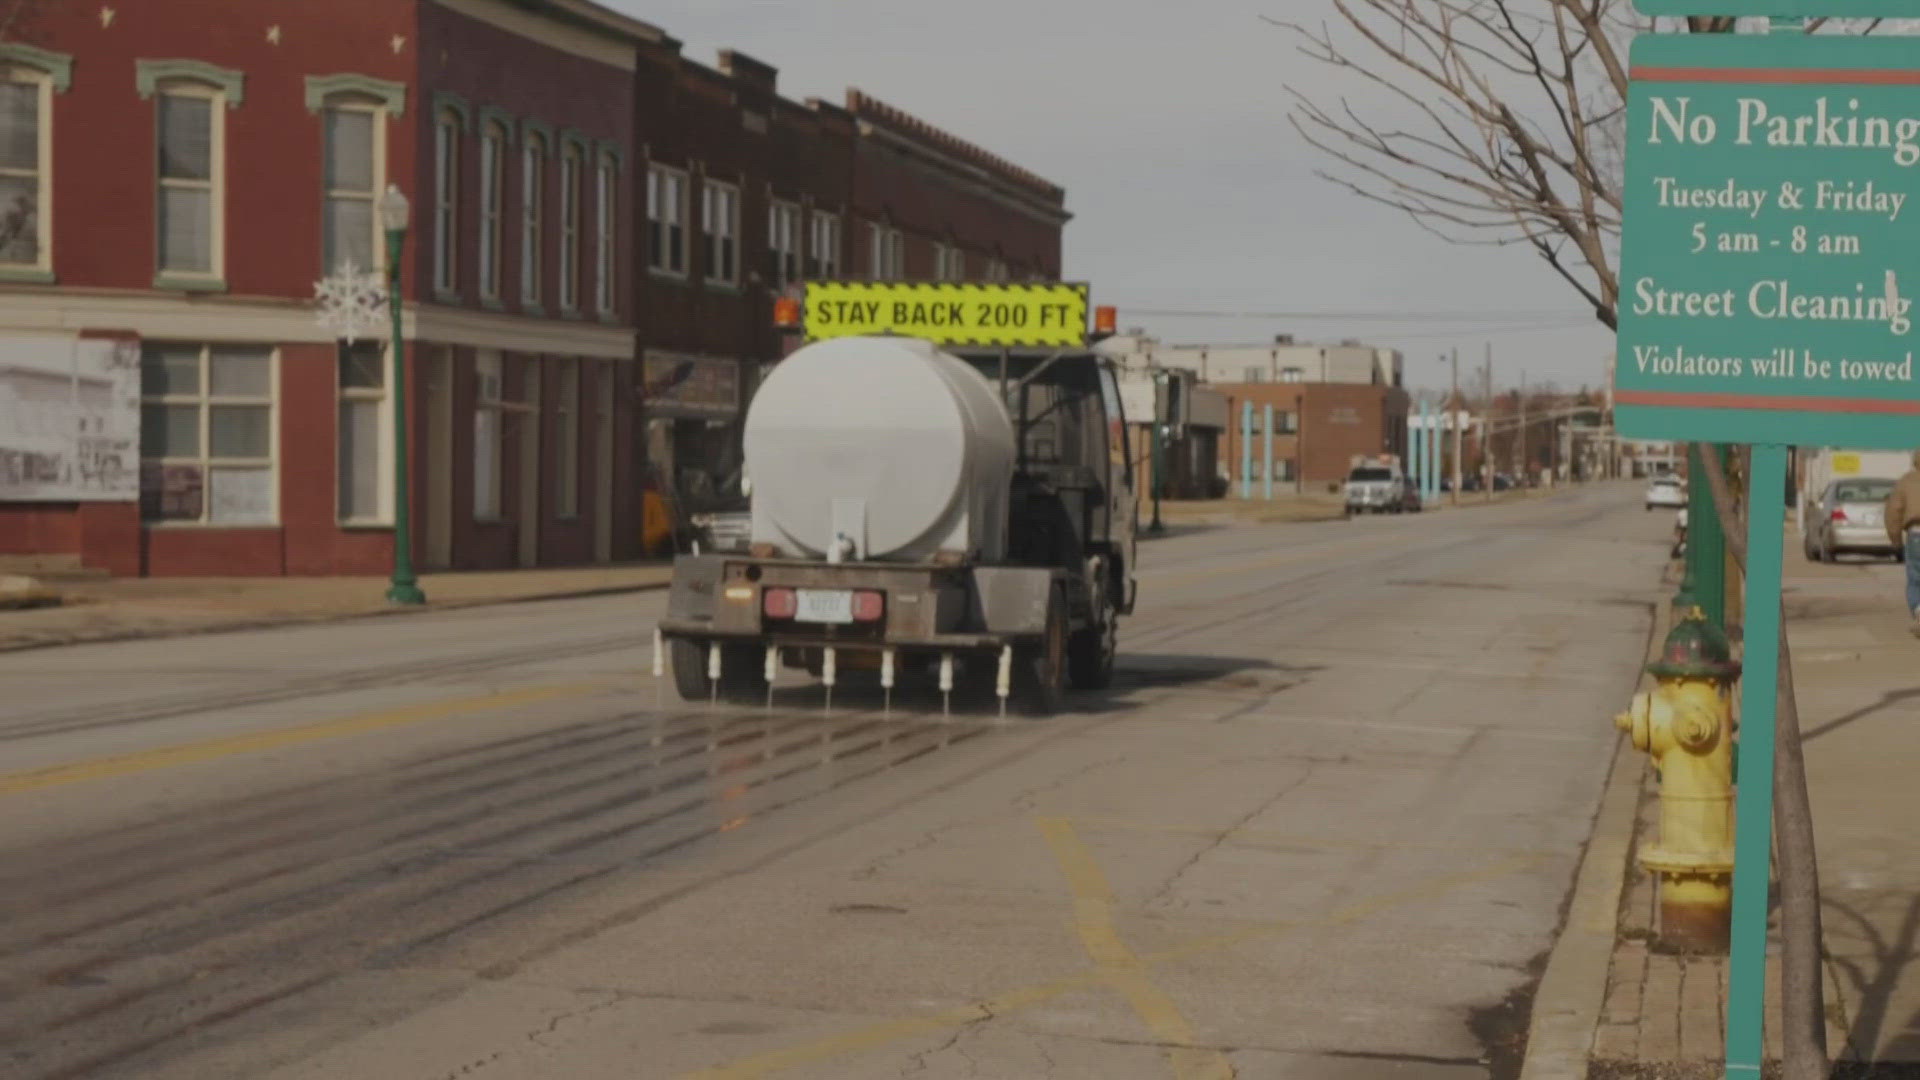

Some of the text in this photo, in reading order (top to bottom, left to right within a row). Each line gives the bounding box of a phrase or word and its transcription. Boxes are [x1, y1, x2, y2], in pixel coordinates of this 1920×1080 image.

[1647, 96, 1920, 167] No Parking
[1653, 177, 1906, 222] Tuesday & Friday
[1691, 222, 1707, 254] 5
[1717, 232, 1759, 252] am
[1790, 225, 1807, 253] 8
[1817, 234, 1860, 254] am
[817, 301, 1070, 328] STAY BACK 200 FT
[1633, 277, 1912, 335] Street Cleaning
[1633, 345, 1912, 381] Violators will be towed
